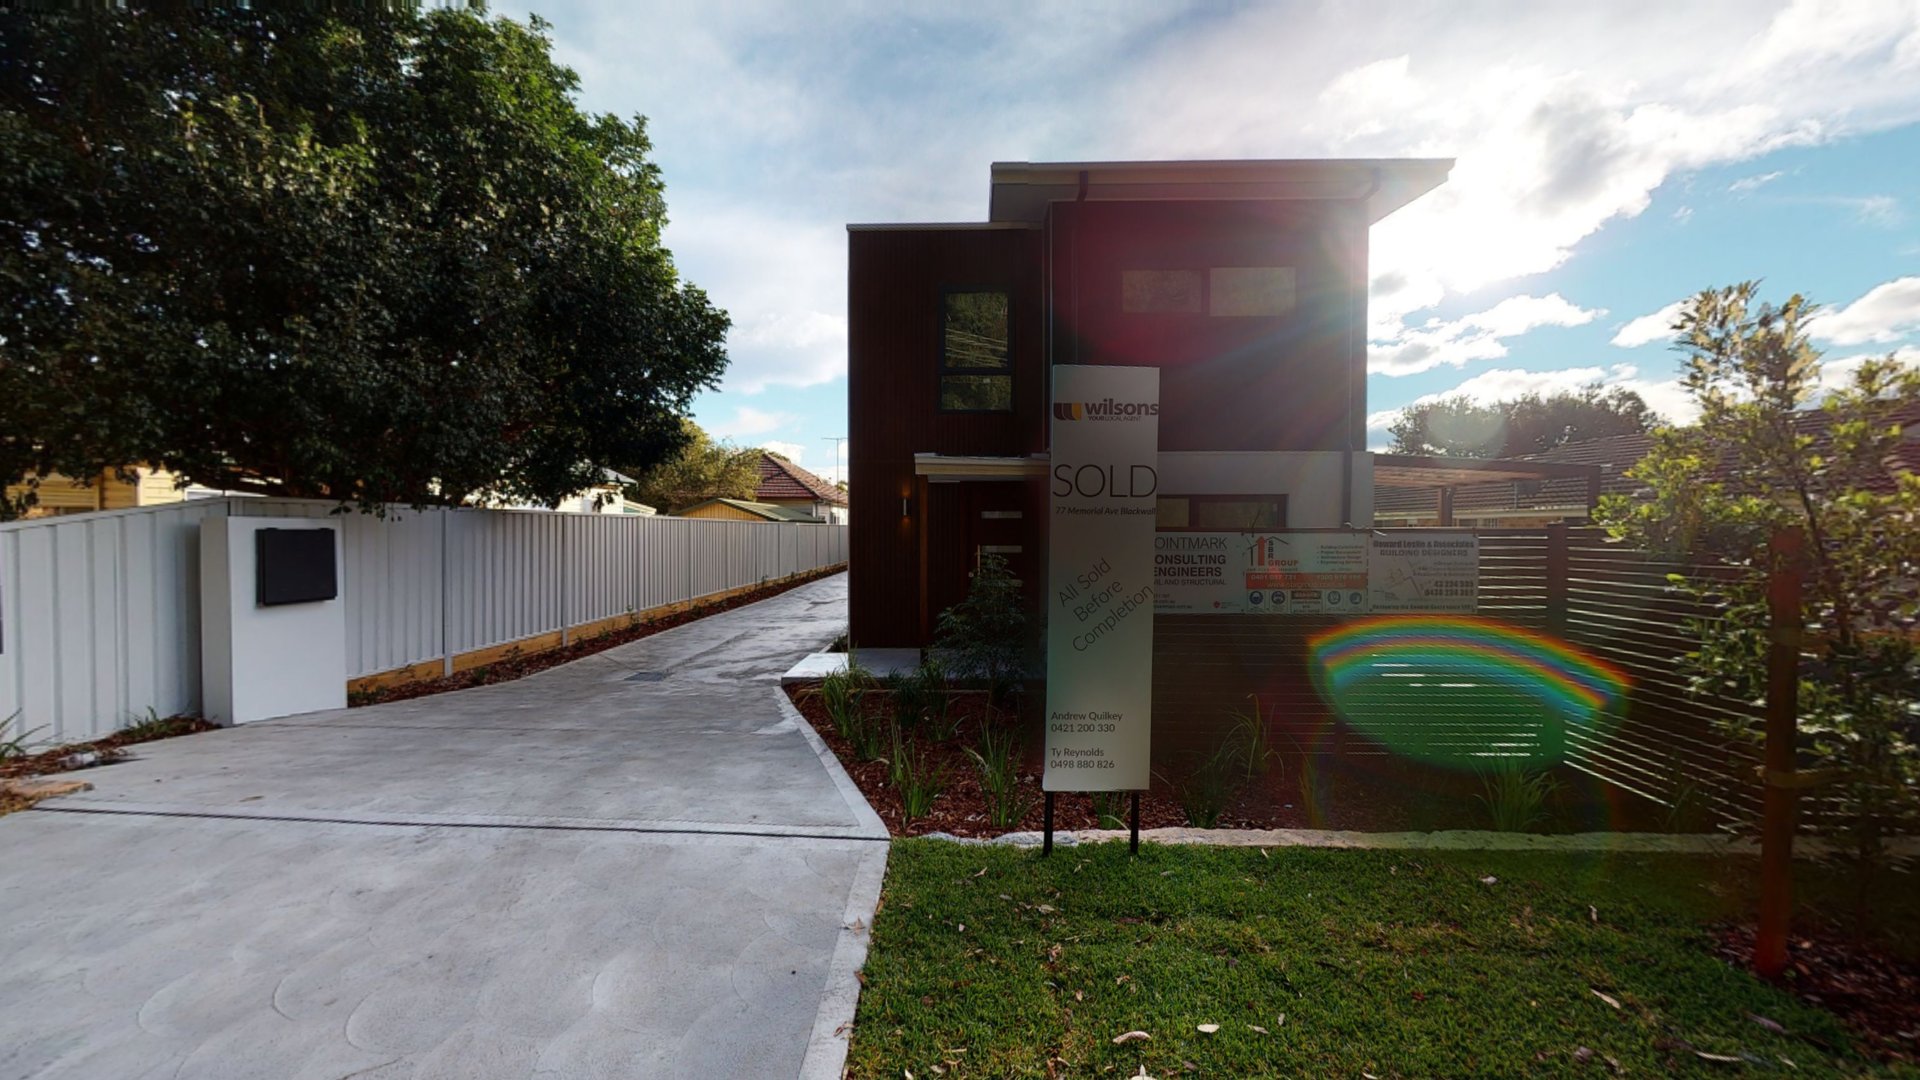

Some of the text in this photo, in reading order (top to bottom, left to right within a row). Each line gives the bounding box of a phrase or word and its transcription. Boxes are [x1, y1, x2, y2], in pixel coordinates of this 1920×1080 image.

[1085, 398, 1159, 416] wilsons
[1053, 464, 1157, 498] SOLD
[1067, 506, 1103, 515] Memorial
[1154, 537, 1228, 550] OINTMARK
[1154, 554, 1226, 565] ONSULTING
[1059, 557, 1111, 607] All Sold
[1073, 581, 1123, 622] Before
[1072, 586, 1154, 652] Completion
[1051, 711, 1124, 722] Andrew Quilkey
[1051, 723, 1116, 733] 0421 200 330
[1051, 747, 1105, 758] Ty Reynolds
[1050, 759, 1115, 769] 0498 880 826
